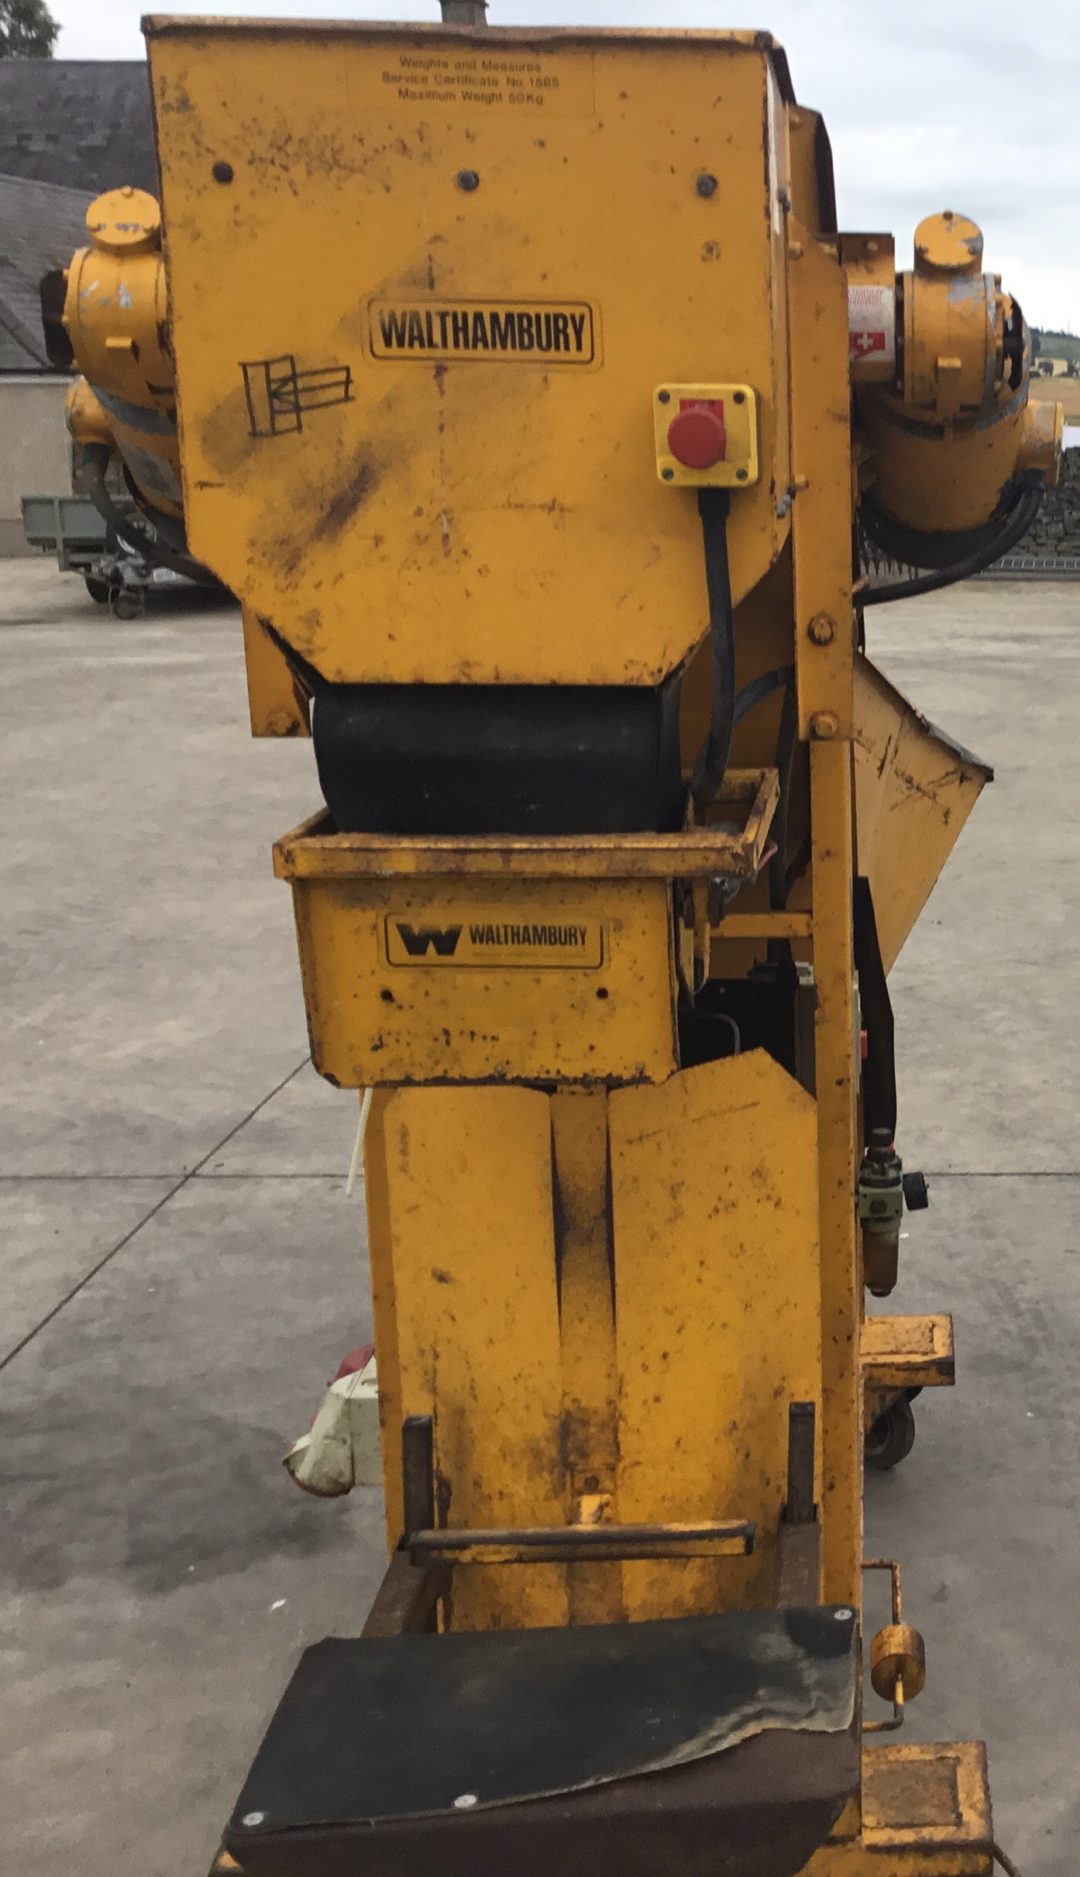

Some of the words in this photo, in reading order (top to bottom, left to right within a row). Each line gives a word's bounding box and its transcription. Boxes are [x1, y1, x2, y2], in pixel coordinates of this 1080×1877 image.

[399, 55, 449, 71] Weights
[454, 59, 477, 70] and
[481, 60, 542, 73] Measures
[382, 71, 429, 84] Service
[434, 74, 499, 87] Certificate
[398, 88, 456, 101] Maximum
[461, 90, 503, 105] Weight
[378, 309, 586, 353] WALTHAMBURY
[468, 923, 588, 947] WALTHAMBURY
